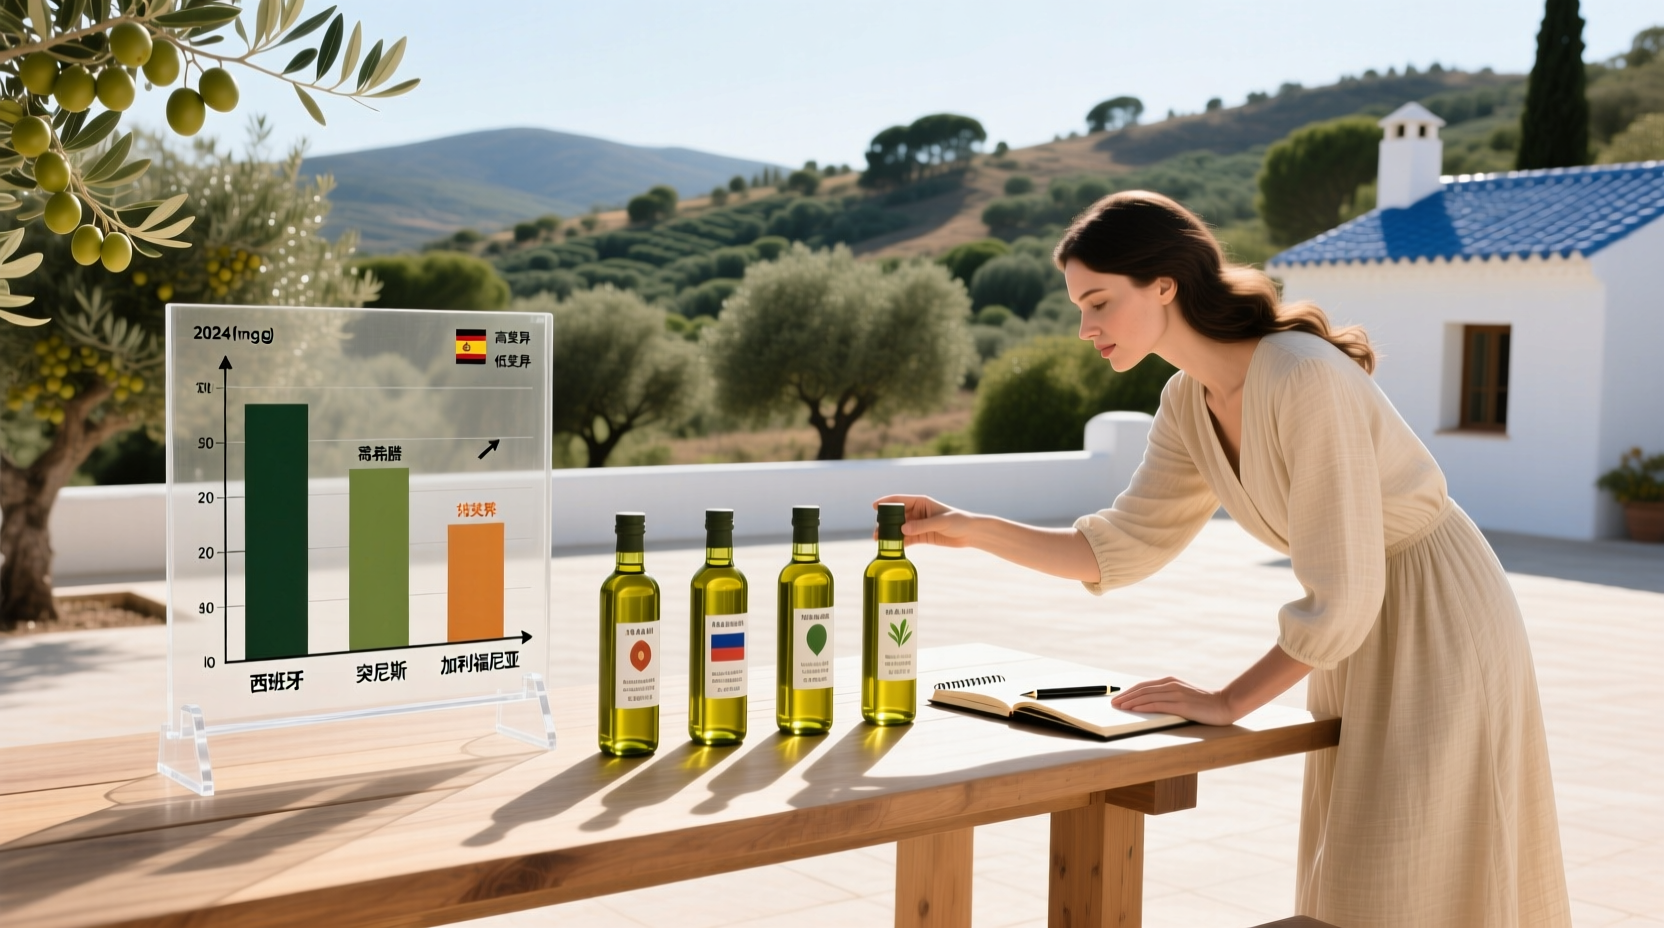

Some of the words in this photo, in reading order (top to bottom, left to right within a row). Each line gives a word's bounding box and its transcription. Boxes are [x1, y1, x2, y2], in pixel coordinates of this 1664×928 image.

[197, 491, 215, 505] 20
[197, 546, 215, 560] 20
[355, 659, 408, 684] 突尼斯
[440, 650, 521, 676] 加利福尼亚
[249, 669, 305, 694] 西班牙
